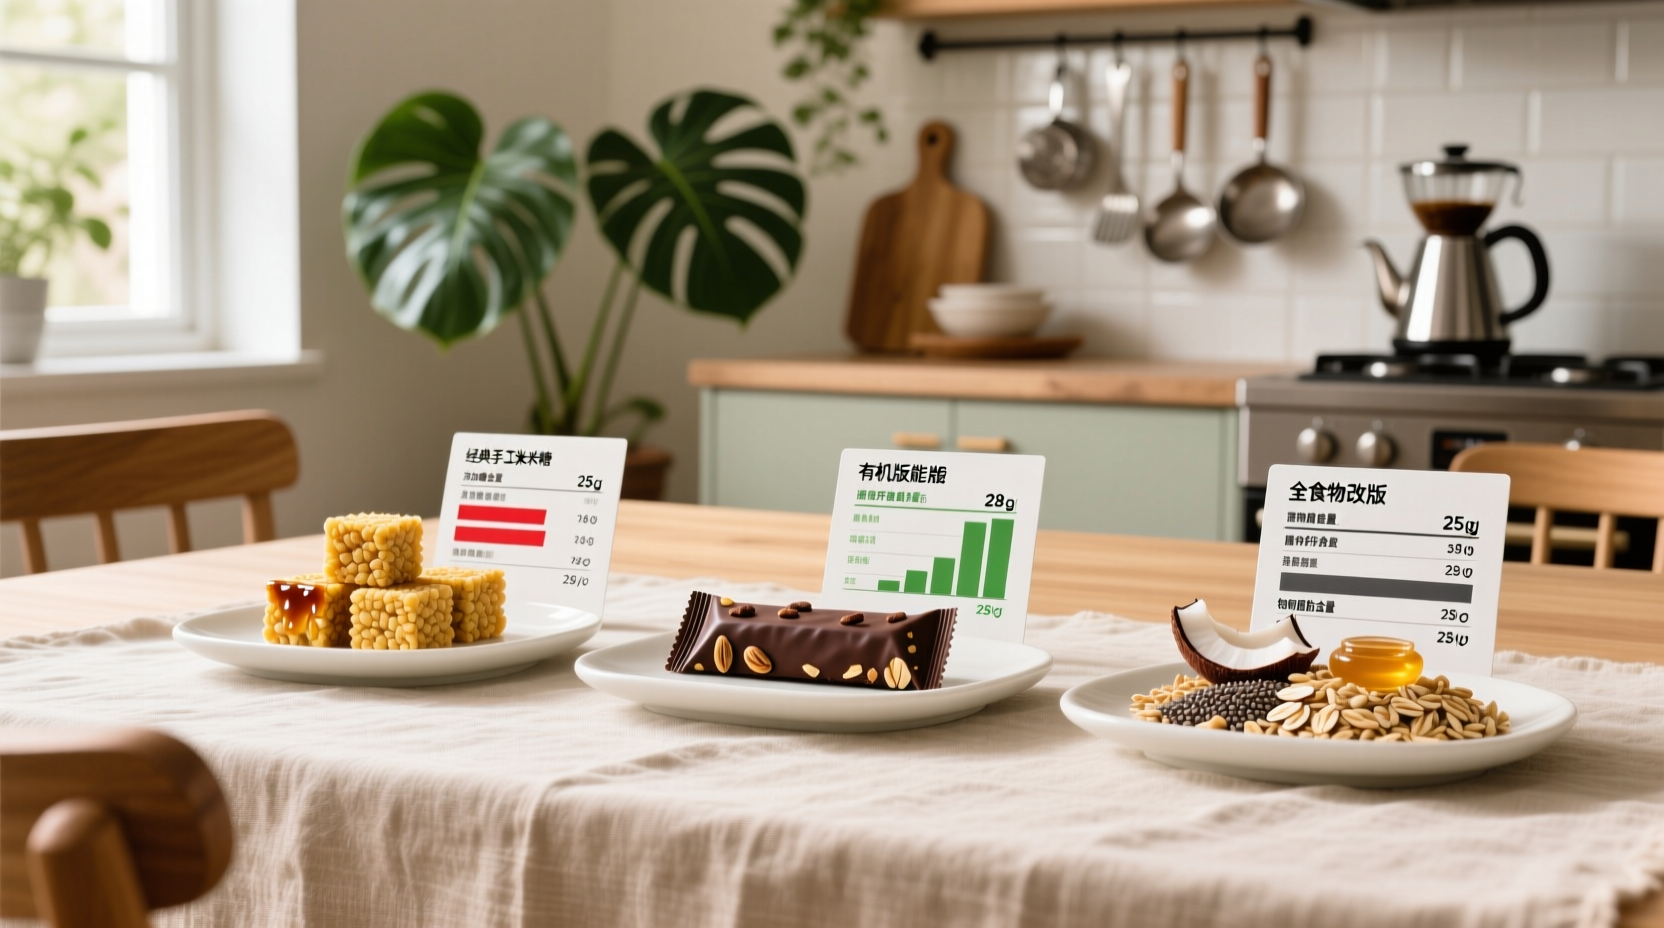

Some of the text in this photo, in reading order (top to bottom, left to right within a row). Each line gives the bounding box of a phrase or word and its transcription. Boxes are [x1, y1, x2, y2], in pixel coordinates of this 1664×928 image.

[577, 474, 603, 491] 25g
[1289, 480, 1388, 505] 全食物改版
[984, 493, 1015, 511] 28g
